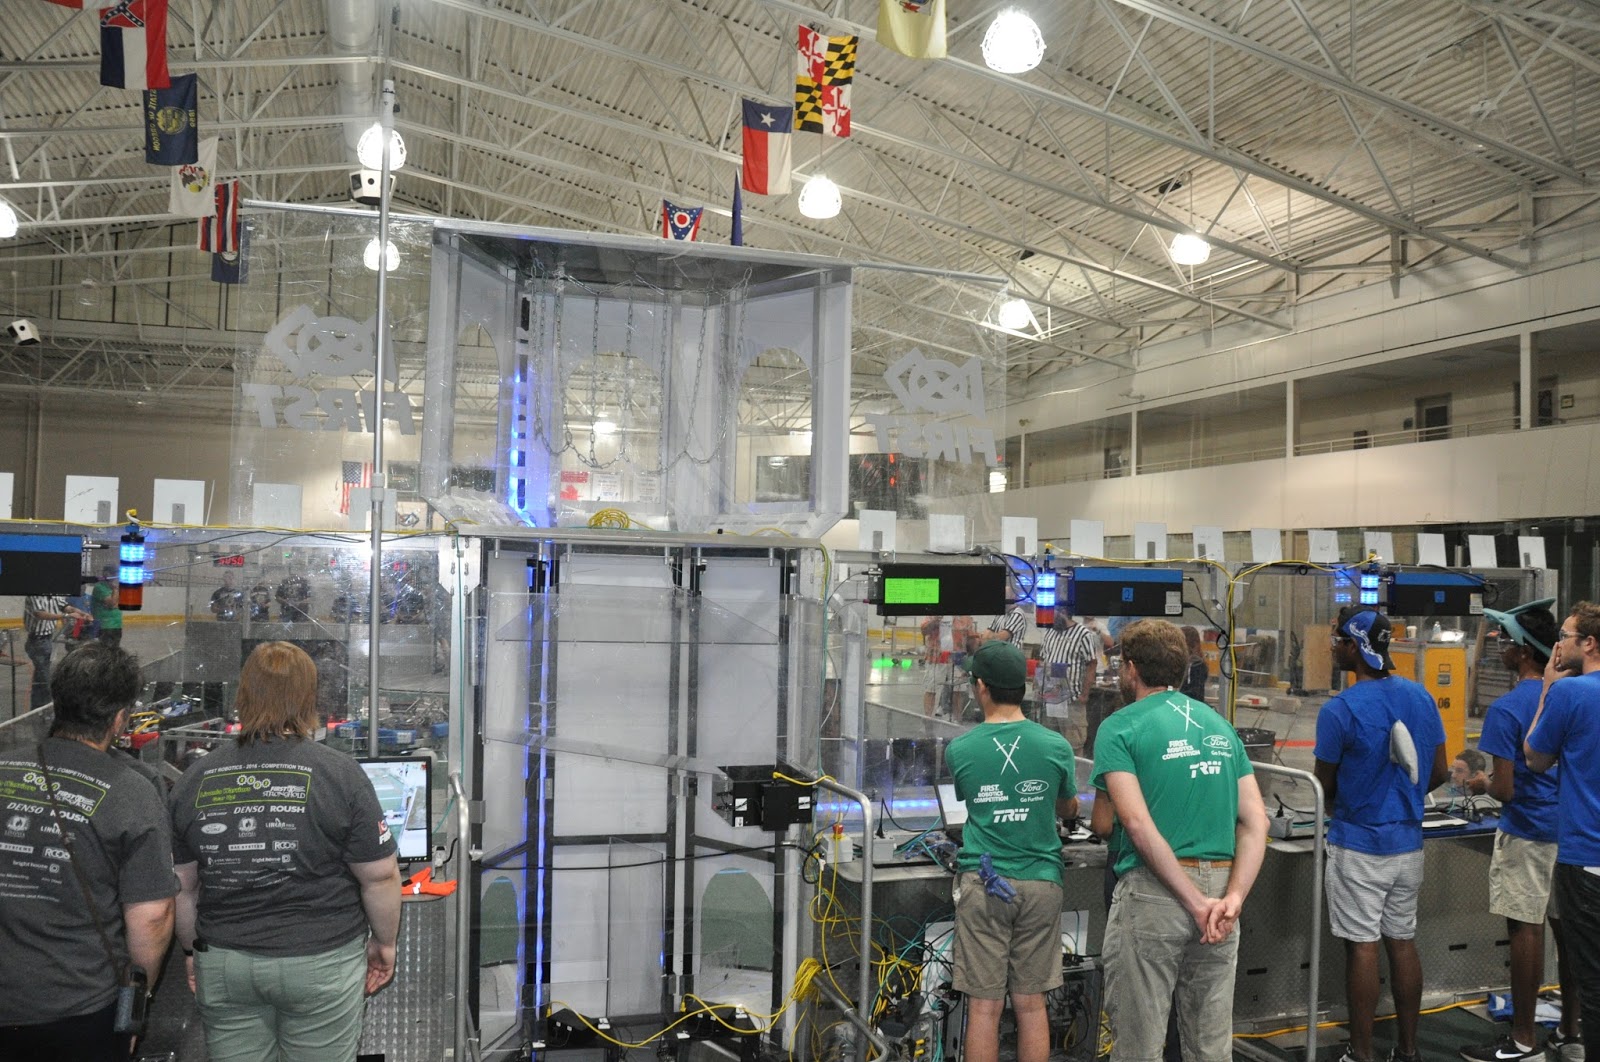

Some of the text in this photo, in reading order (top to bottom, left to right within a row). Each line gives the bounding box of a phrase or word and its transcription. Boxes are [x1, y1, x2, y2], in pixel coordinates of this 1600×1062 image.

[1437, 697, 1451, 709] 06
[1169, 739, 1188, 747] FIRST
[1166, 745, 1194, 753] ROBOTICS
[1162, 750, 1201, 760] COMPETITION
[217, 764, 243, 773] ROBOTICS
[297, 765, 312, 773] TEAM
[1189, 760, 1222, 778] TRW
[56, 767, 96, 782] COMPETITION
[95, 778, 111, 790] TEAM
[980, 784, 1000, 793] FIRST
[977, 790, 1004, 798] ROBOTICS
[973, 795, 1009, 803] COMPETITION
[7, 802, 44, 814] DENSO
[233, 805, 265, 814] DENSO
[270, 805, 306, 813] ROUSH
[993, 808, 1030, 823] TRW
